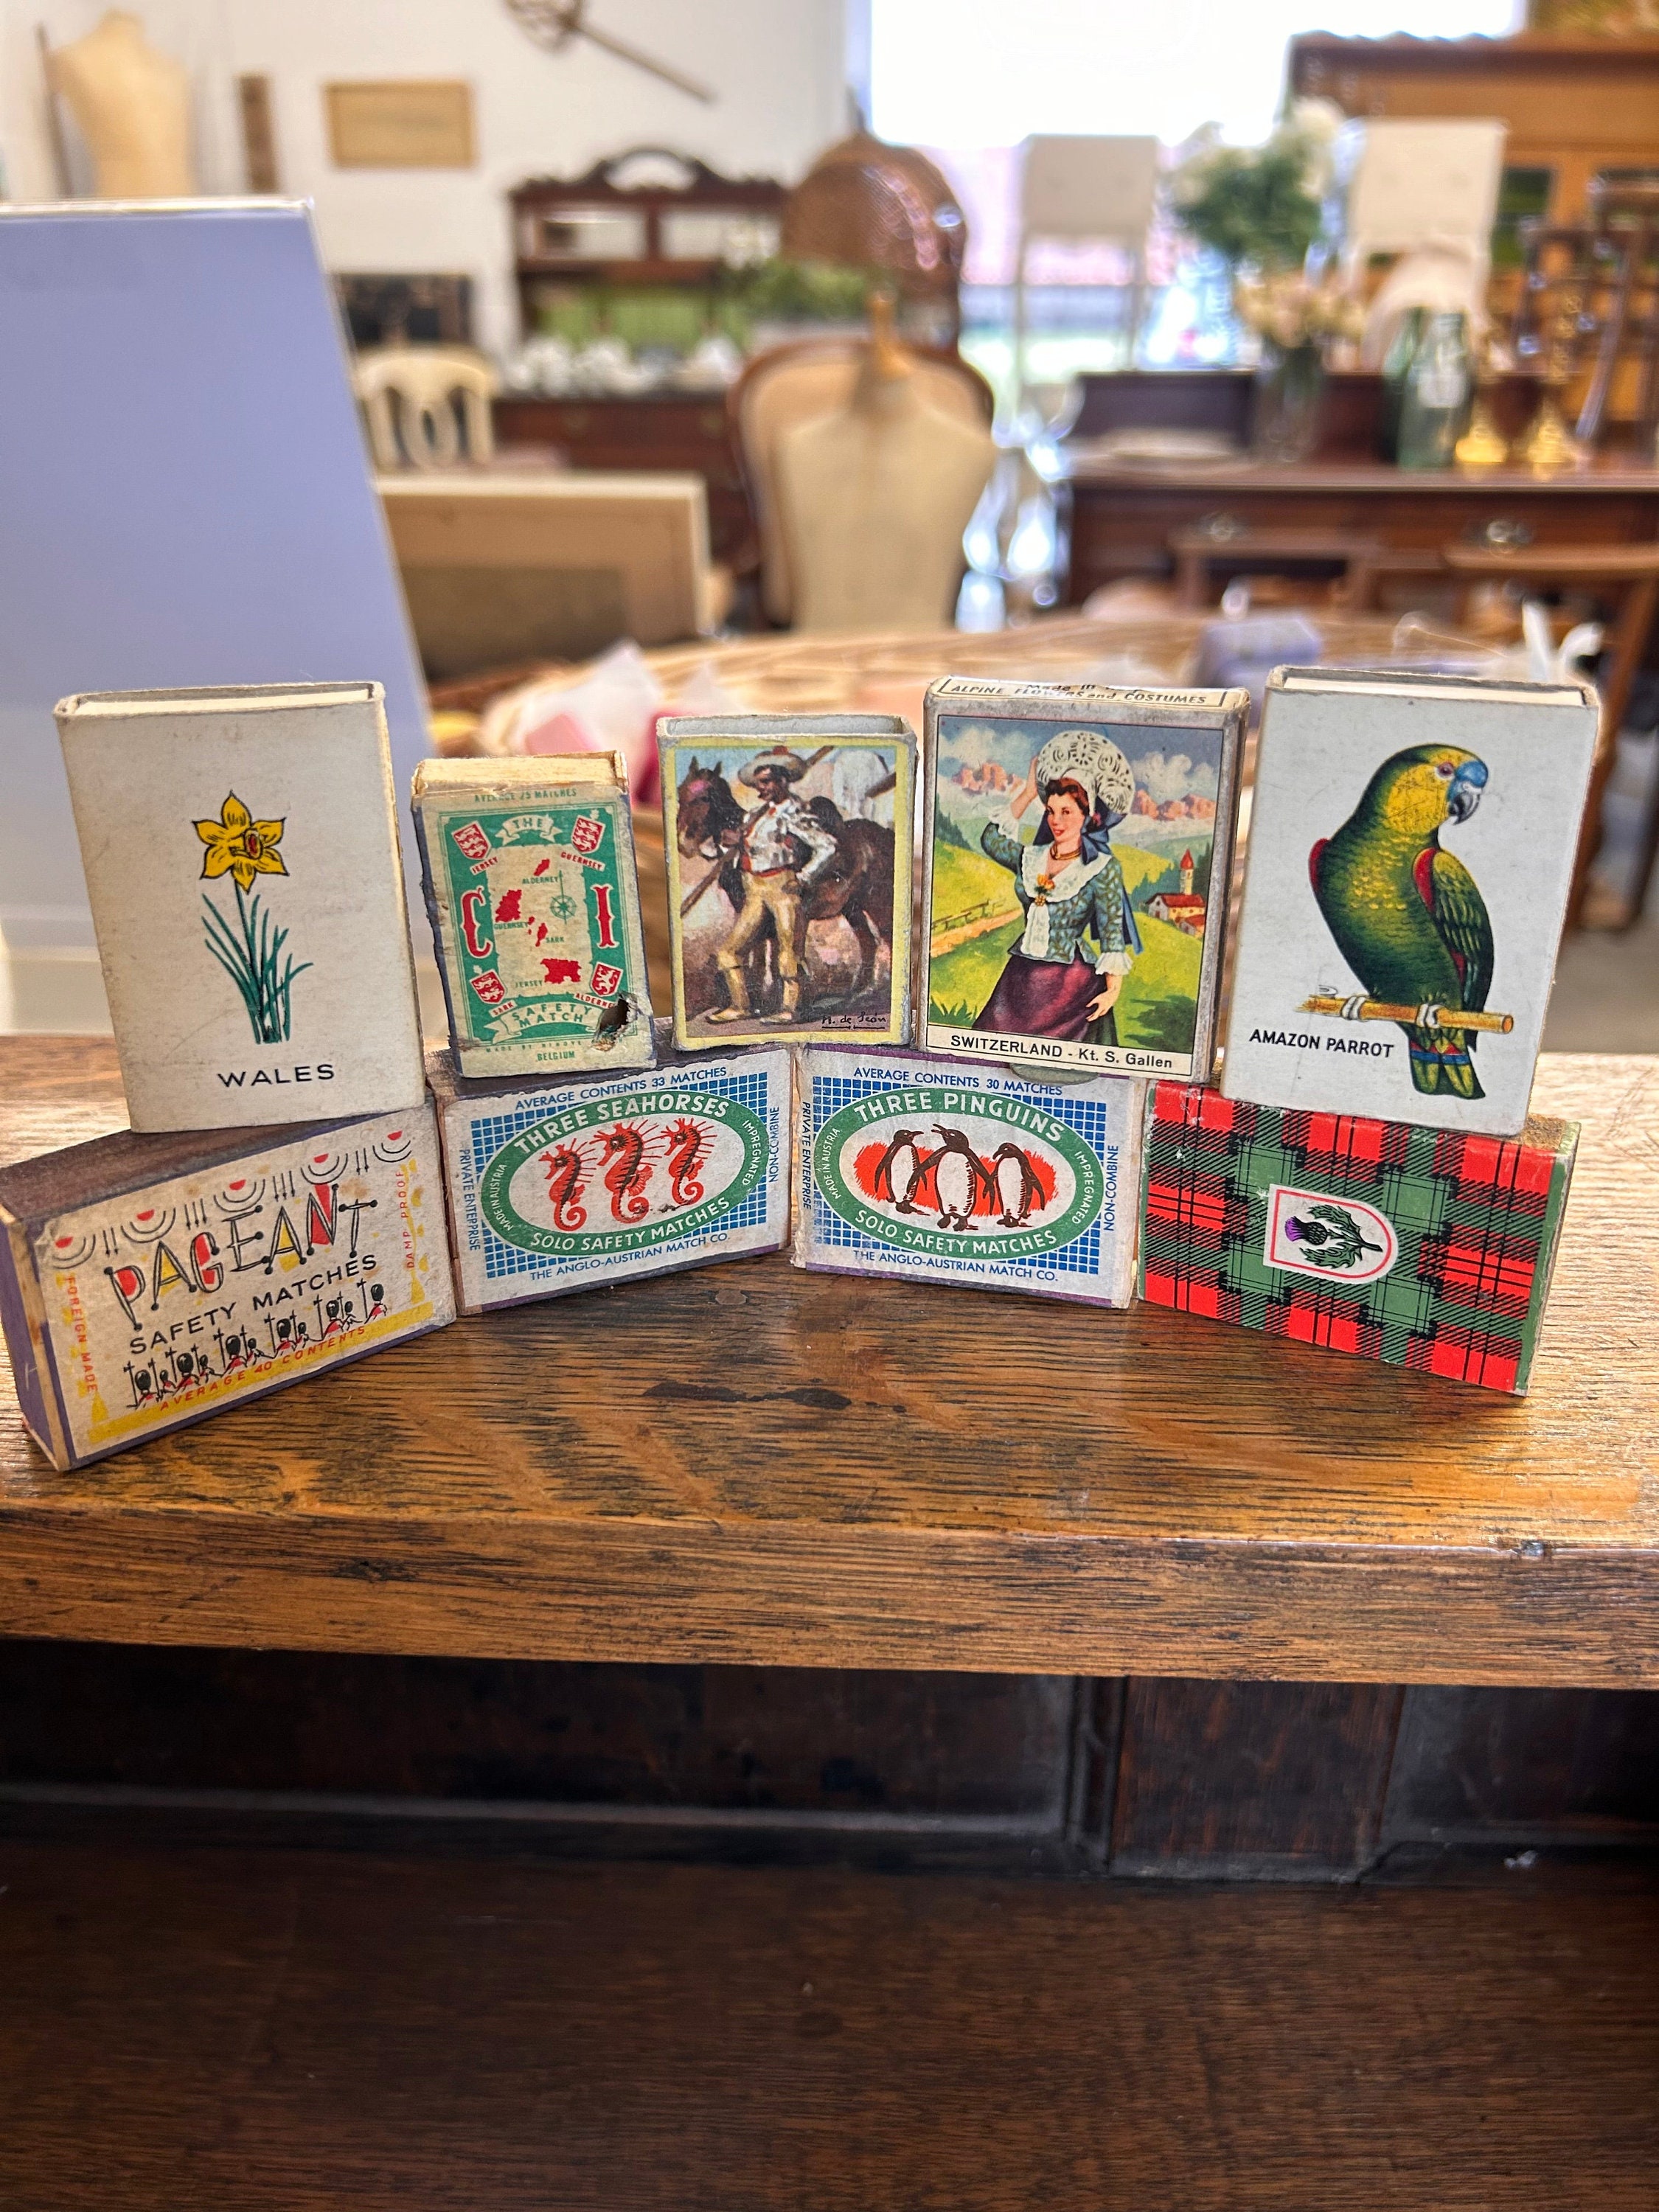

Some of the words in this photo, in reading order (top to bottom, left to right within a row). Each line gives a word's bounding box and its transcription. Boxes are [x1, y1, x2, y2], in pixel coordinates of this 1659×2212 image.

[951, 685, 1006, 694] ALPINE
[1124, 692, 1206, 704] COSTUMES
[535, 788, 577, 799] MATCHES
[512, 817, 544, 829] THE
[472, 855, 498, 874] JERSEY
[560, 851, 603, 871] GUERNSEY
[521, 876, 559, 885] ALDERNEY
[460, 886, 493, 958] C
[591, 884, 619, 948] I
[493, 922, 529, 931] GUERNSEY
[516, 980, 543, 989] JERSEY
[576, 993, 616, 1009] ALDERNE
[493, 1001, 515, 1016] SARK
[511, 1003, 592, 1021] SAFETY
[519, 1012, 583, 1028] MATCH
[537, 1051, 575, 1061] BELGIUM
[950, 1034, 1062, 1057] SWITZERLAND
[1079, 1048, 1099, 1062] Kt.
[1105, 1051, 1119, 1063] S.
[1125, 1052, 1173, 1069] Gallen
[1249, 1028, 1320, 1050] AMAZON
[1326, 1037, 1395, 1059] PARROT
[217, 1063, 335, 1088] WALES
[515, 1091, 575, 1111] AVERAGE
[580, 1080, 647, 1099] CONTENTS
[652, 1077, 665, 1088] 33
[670, 1066, 727, 1084] MATCHES
[853, 1067, 910, 1081] AVERAGE
[914, 1072, 980, 1088] CONTENTS
[987, 1077, 1000, 1090] 30
[1004, 1080, 1062, 1096] MATCHES
[514, 1108, 588, 1155] THREE
[598, 1093, 730, 1121] SEAHORSES
[801, 1101, 812, 1147] PRIVATE
[854, 1091, 933, 1123] THREE
[943, 1092, 1065, 1142] PINGUINS
[742, 1119, 762, 1186] IMPREGNATED
[821, 1127, 841, 1163] AUSTRIA
[459, 1149, 475, 1191] PRIVATE
[490, 1164, 508, 1198] AUSTRIA
[801, 1149, 812, 1210] ENTERPRISE
[822, 1164, 830, 1173] IN
[396, 1171, 408, 1220] PROOF
[490, 1198, 501, 1210] IN
[824, 1174, 842, 1200] MADE
[1071, 1150, 1094, 1225] IMPREGNATED
[1103, 1144, 1119, 1232] NON-COMBINE
[465, 1193, 481, 1251] ENTERPRISE
[493, 1208, 514, 1231] MADE
[530, 1232, 576, 1252] SOLO
[581, 1232, 647, 1251] SAFETY
[650, 1197, 730, 1242] MATCHES
[855, 1209, 898, 1239] SOLO
[902, 1229, 968, 1253] SAFETY
[973, 1229, 1057, 1254] MATCHES
[103, 1183, 378, 1331] PAGEANT
[403, 1230, 415, 1270] DAMP
[530, 1267, 552, 1281] THE
[556, 1246, 663, 1276] ANGLO-AUSTRIAN
[667, 1236, 706, 1253] MATCH
[708, 1232, 731, 1245] CO.
[853, 1250, 876, 1262] THE
[879, 1252, 986, 1273] ANGLO-AUSTRIAN
[989, 1264, 1033, 1279] MATCH
[1036, 1269, 1059, 1282] CO.
[130, 1301, 237, 1355] SAFETY
[252, 1253, 377, 1312] MATCHES
[65, 1275, 88, 1343] FOREIGN
[81, 1352, 98, 1393] MADE
[160, 1368, 246, 1411] AVERAGE
[254, 1360, 273, 1374] 40
[282, 1326, 366, 1364] CONTENTS
